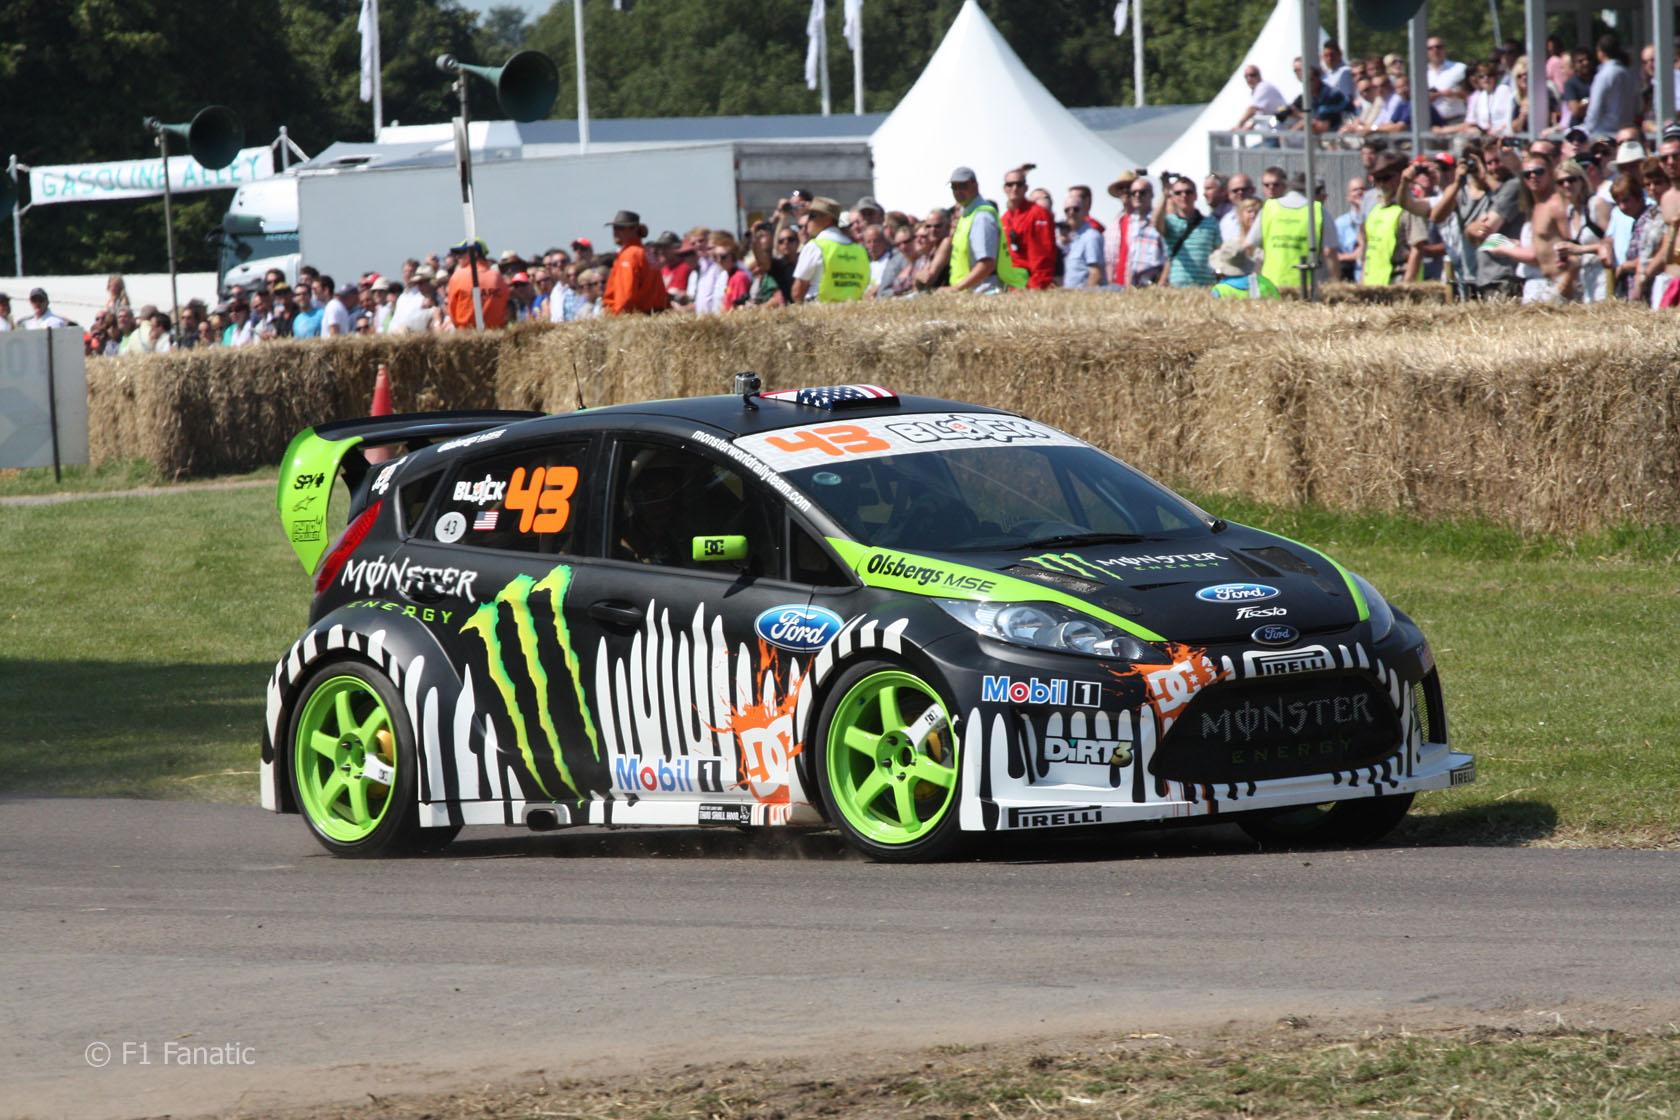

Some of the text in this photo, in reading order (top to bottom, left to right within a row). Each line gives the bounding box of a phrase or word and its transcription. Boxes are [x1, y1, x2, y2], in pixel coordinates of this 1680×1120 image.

[42, 154, 260, 197] GASOLINE ALLEY
[764, 423, 892, 457] 43
[691, 430, 812, 512] monsterworldrallyteam.com
[504, 465, 579, 533] 43
[443, 520, 458, 535] 43
[867, 554, 997, 593] Olsbergs MSE
[347, 600, 453, 624] ENERGY
[771, 609, 830, 645] Ford
[1235, 606, 1288, 621] Fiesta
[1251, 650, 1327, 676] PIRELLI
[982, 675, 1069, 706] Mobil
[1231, 739, 1353, 765] ENERGY
[615, 757, 694, 793] Mobil
[1008, 805, 1103, 828] PIRELLI
